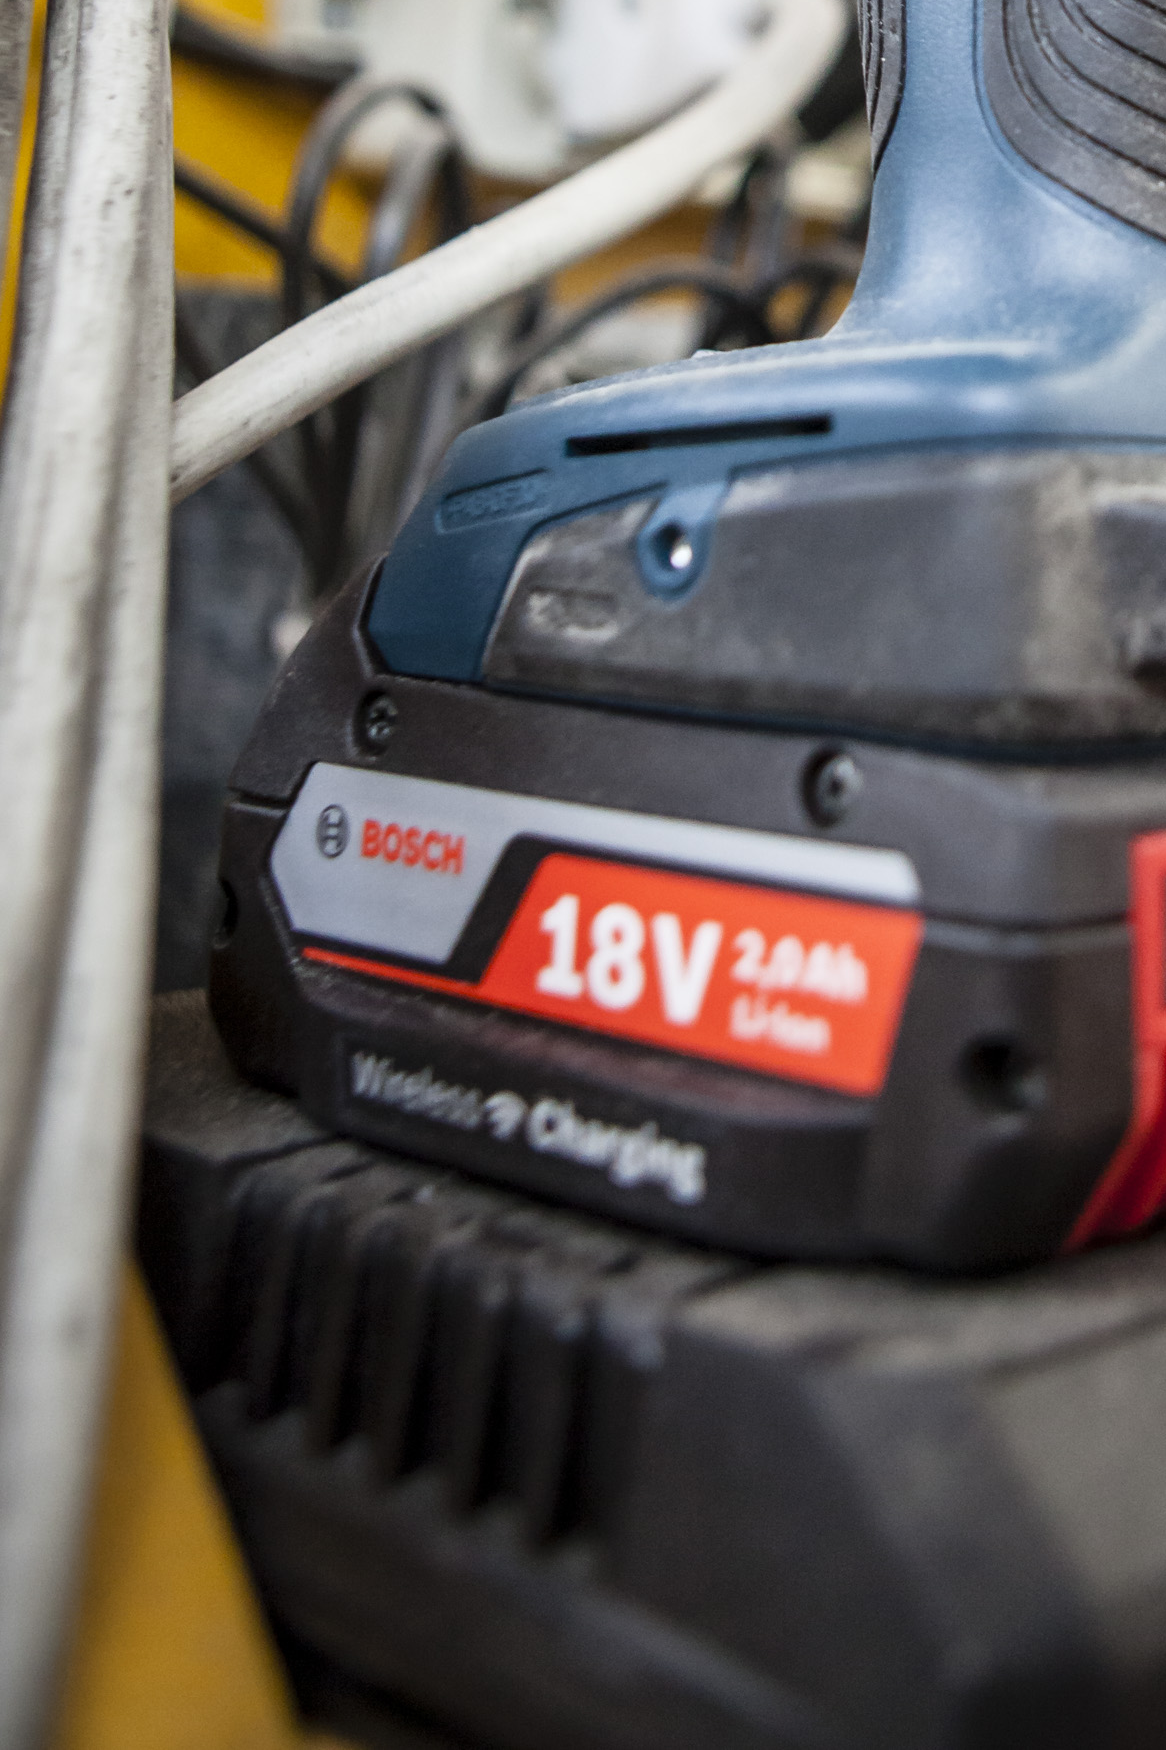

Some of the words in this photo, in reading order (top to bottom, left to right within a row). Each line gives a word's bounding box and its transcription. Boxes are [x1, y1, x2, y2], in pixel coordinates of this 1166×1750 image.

[360, 818, 467, 875] BOSCH
[535, 893, 725, 1026] 18V
[527, 1097, 706, 1204] Charging
